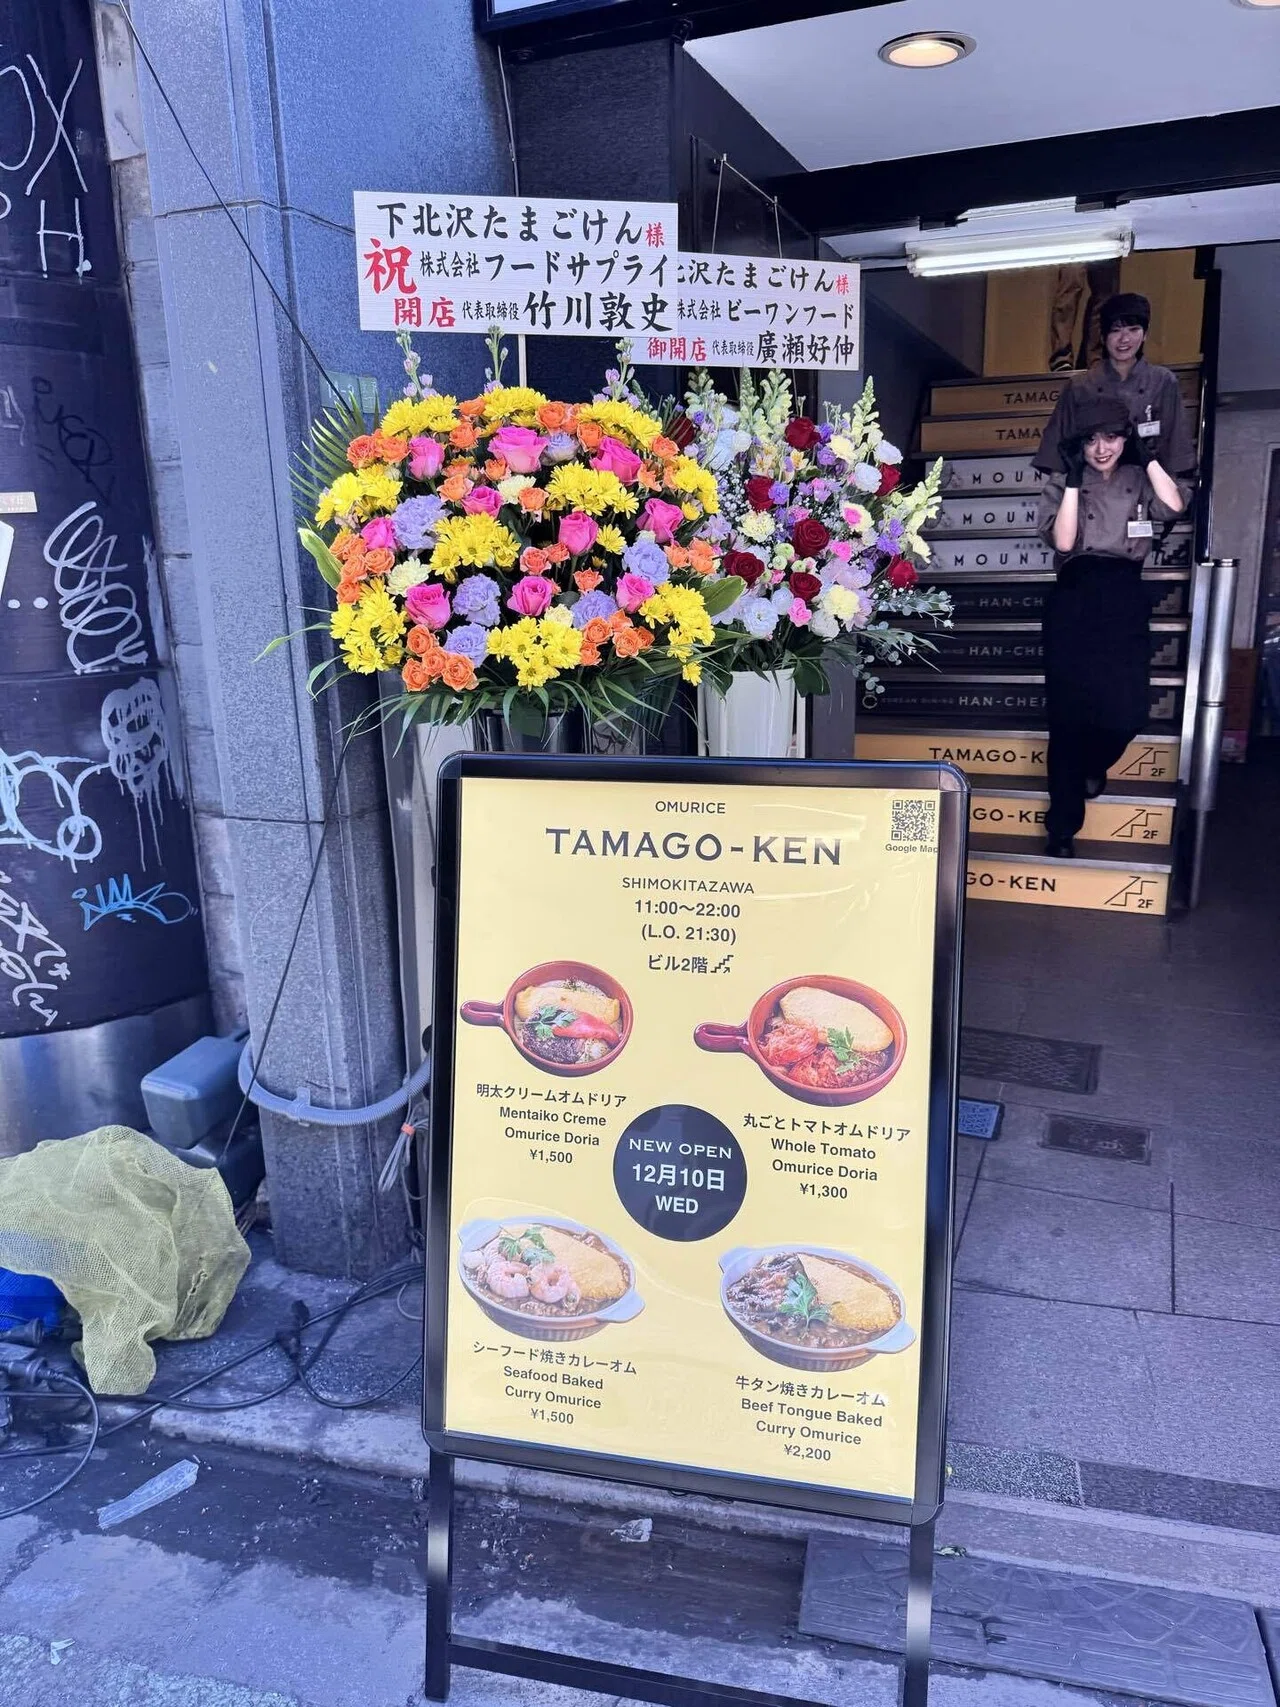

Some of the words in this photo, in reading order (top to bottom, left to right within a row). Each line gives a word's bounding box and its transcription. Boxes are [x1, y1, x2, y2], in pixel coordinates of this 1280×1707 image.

[363, 238, 418, 294] 祝
[954, 552, 1049, 566] MOUNT
[1151, 767, 1167, 777] 2F
[655, 801, 726, 814] OMURICE
[1142, 830, 1158, 839] 2F
[545, 827, 841, 866] TAMAGO-KEN
[885, 843, 918, 854] Google
[622, 877, 755, 894] SHIMOKITAZAWA
[1137, 899, 1154, 909] 2F
[642, 924, 680, 941] (L.O.
[685, 926, 737, 946] 21:30)
[648, 953, 708, 974] ビル2階
[476, 1083, 627, 1108] 明太クリームオムドリア
[499, 1106, 559, 1123] Mentaiko
[563, 1111, 607, 1127] Creme
[743, 1112, 911, 1142] 丸ごとトマトオムドリア
[504, 1126, 561, 1143] Omurice
[564, 1131, 600, 1147] Doria
[529, 1149, 573, 1164] ¥1,500
[629, 1138, 672, 1153] NEW
[679, 1143, 732, 1160] OPEN
[771, 1137, 816, 1154] Whole
[820, 1142, 876, 1160] Tomato
[632, 1163, 725, 1192] 12月10日
[772, 1158, 834, 1177] Omurice
[838, 1165, 878, 1182] Doria
[799, 1182, 848, 1199] ¥1,300
[655, 1194, 699, 1214] WED
[473, 1341, 637, 1376] シーフード焼きカレーオム
[503, 1365, 558, 1384] Seafood
[562, 1373, 604, 1390] Baked
[505, 1385, 541, 1403] Curry
[545, 1390, 602, 1409] Omurice
[735, 1375, 886, 1408] 牛タン焼きカレーオム
[531, 1407, 574, 1425] ¥1,500
[741, 1397, 774, 1414] Beef
[777, 1402, 832, 1421] Tongue
[836, 1410, 883, 1427] Baked
[756, 1420, 796, 1439] Curry
[800, 1426, 862, 1446] Omurice
[784, 1444, 831, 1462] ¥2,200
